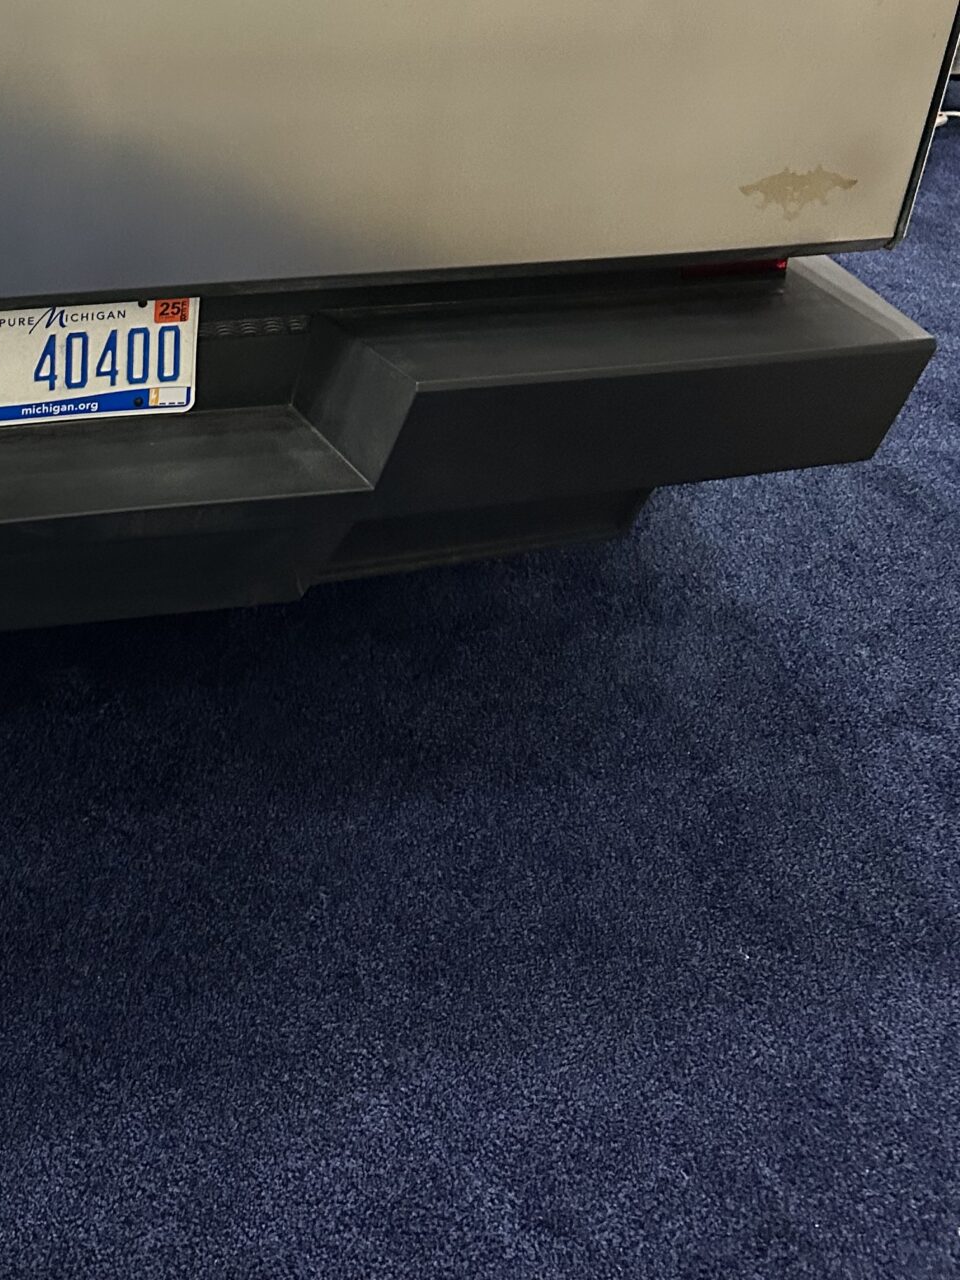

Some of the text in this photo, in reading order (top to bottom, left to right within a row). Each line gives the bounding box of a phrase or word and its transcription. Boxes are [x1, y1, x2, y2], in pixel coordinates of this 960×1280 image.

[159, 302, 181, 316] 25
[0, 306, 127, 335] PURE MICHIGAN
[33, 325, 181, 391] 40400
[21, 400, 99, 416] michigan.org
